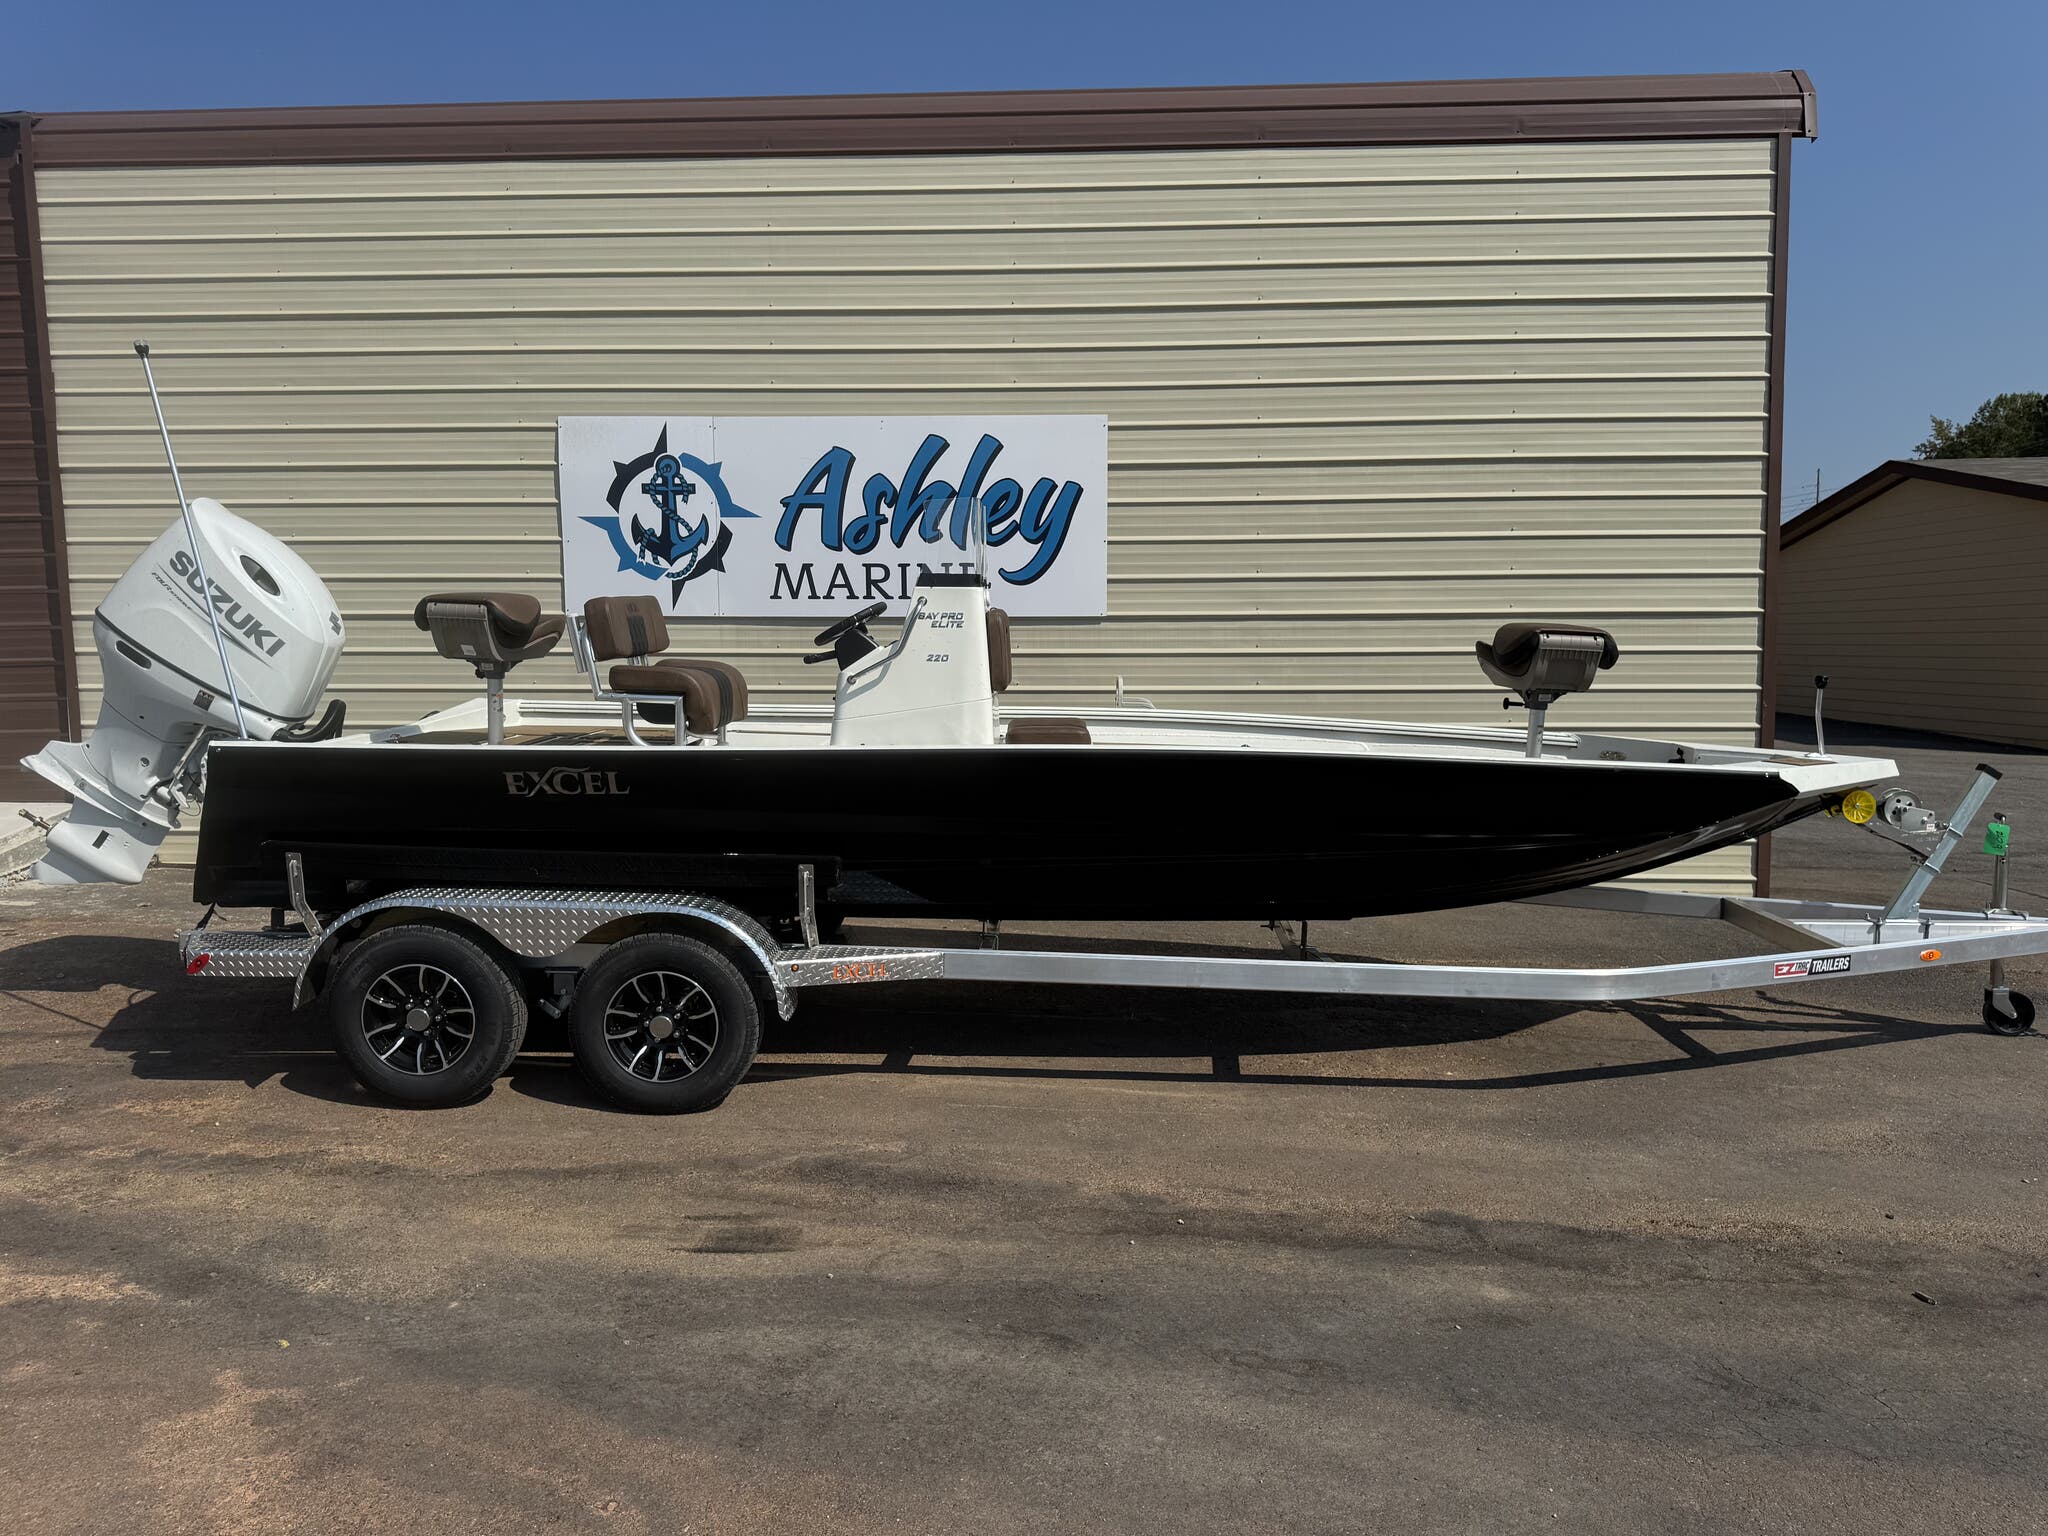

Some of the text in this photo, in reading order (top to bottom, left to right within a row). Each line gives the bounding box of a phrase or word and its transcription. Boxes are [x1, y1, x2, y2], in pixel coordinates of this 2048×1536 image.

[774, 433, 1083, 586] Ashley
[769, 563, 975, 600] MARI
[169, 550, 286, 658] SUZUKI
[917, 612, 964, 620] BAY PRO
[931, 621, 964, 629] ELITE
[926, 654, 949, 662] 220
[502, 766, 630, 797] EXCEL
[1811, 957, 1850, 973] TRAILERS
